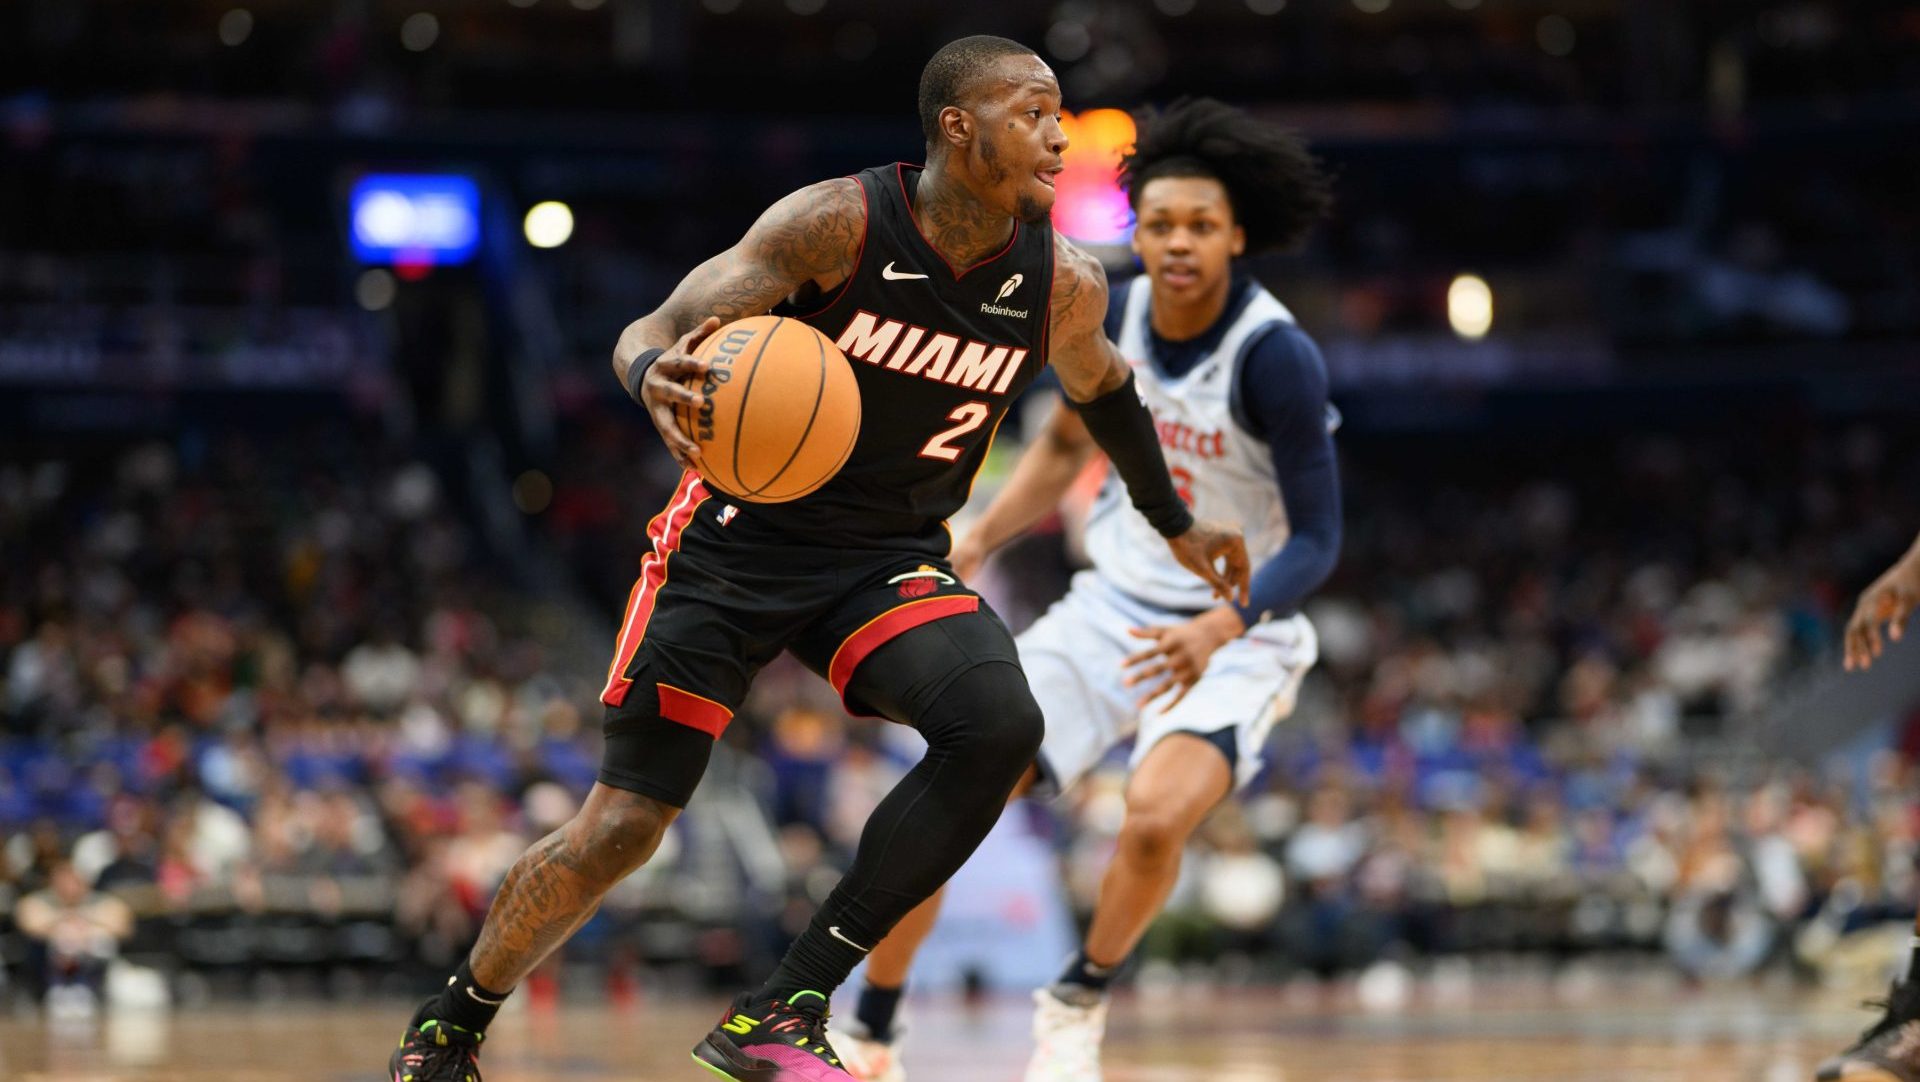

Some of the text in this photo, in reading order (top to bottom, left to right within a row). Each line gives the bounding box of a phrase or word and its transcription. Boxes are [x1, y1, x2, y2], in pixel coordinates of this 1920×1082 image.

[981, 303, 1028, 319] Robinhood
[698, 329, 757, 441] Wilson
[834, 309, 1030, 395] MIAMI
[917, 400, 991, 463] 2
